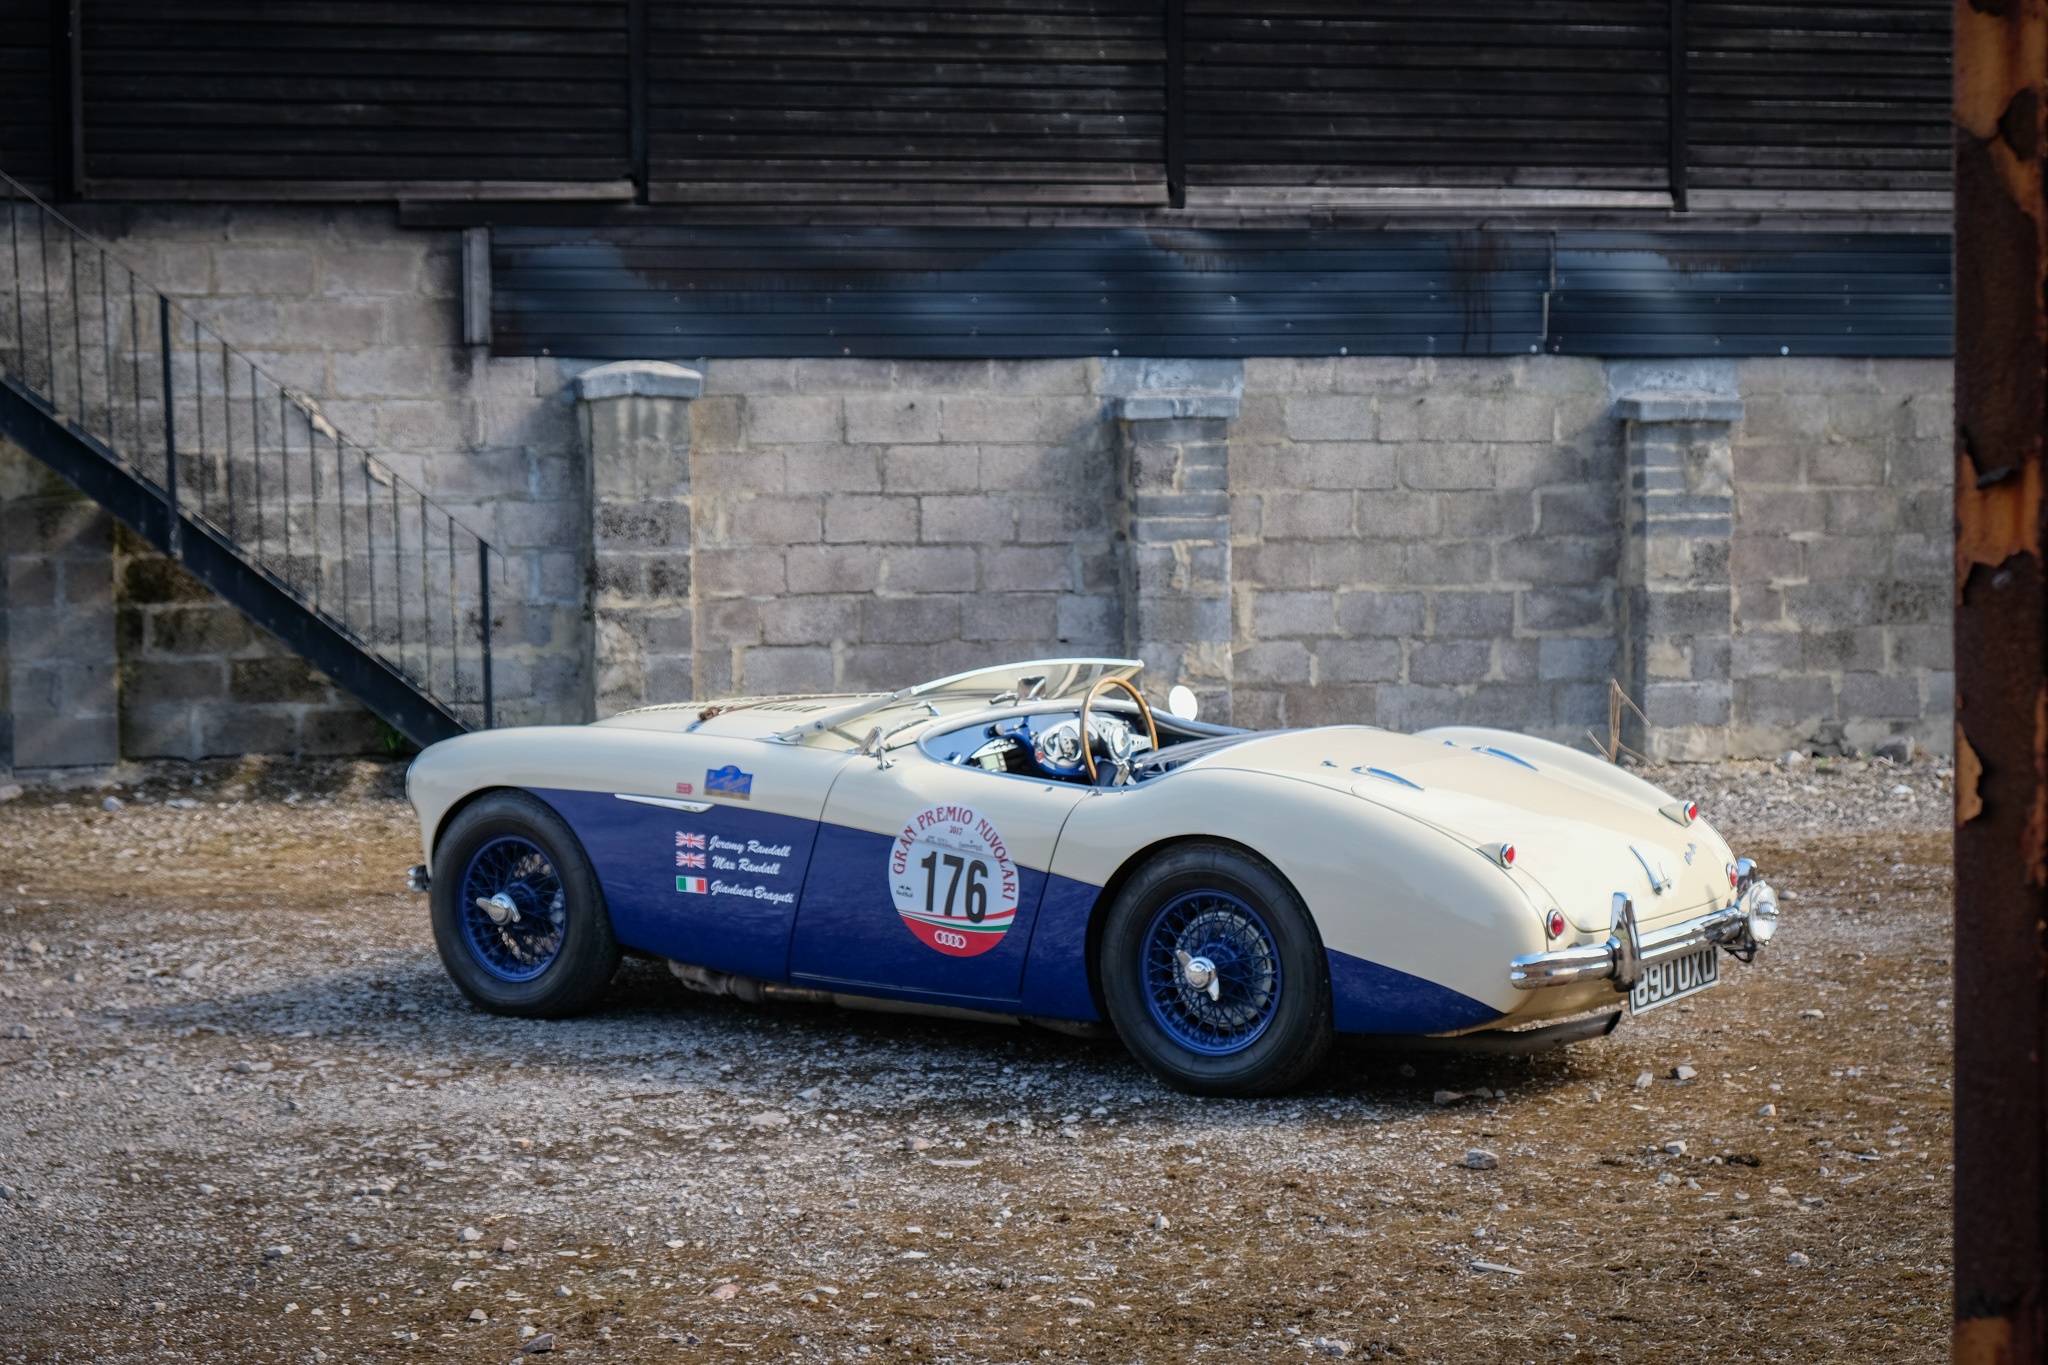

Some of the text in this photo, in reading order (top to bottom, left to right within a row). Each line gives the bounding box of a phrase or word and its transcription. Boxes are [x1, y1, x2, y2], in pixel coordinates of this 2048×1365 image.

[949, 825, 964, 836] 2017
[709, 835, 791, 857] Jeremy Randall
[892, 806, 1017, 902] GRAN PREMIO NUVOLARI
[712, 855, 781, 875] Max Randall
[711, 879, 795, 905] Gianluca Braguti
[921, 850, 988, 924] 176
